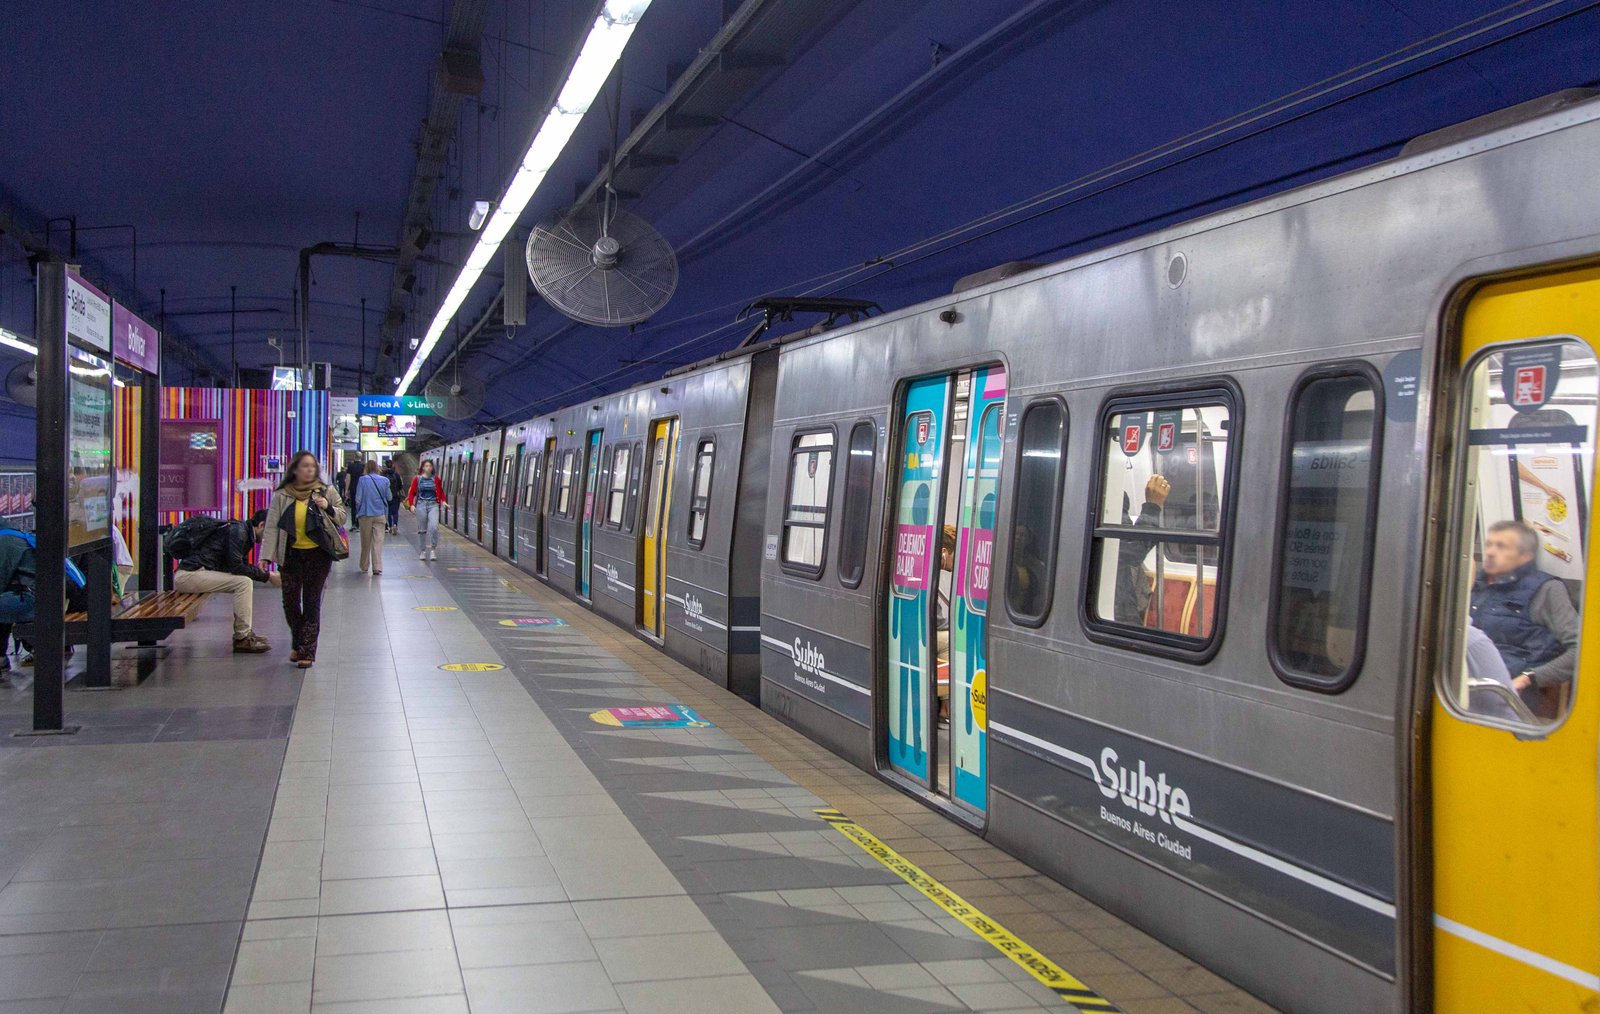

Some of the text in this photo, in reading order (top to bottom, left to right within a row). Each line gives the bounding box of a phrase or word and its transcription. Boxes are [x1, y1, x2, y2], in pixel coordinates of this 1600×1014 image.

[71, 289, 86, 317] Salida
[369, 400, 401, 409] Línea A
[414, 400, 435, 409] Línea
[898, 532, 926, 556] DEJEMOS
[896, 555, 915, 577] BAJAR
[973, 565, 989, 590] SUB
[684, 592, 703, 619] Subte
[793, 636, 825, 675] Subte
[1099, 746, 1192, 825] Subte
[1100, 805, 1192, 860] Buenos Aires Ciudad
[870, 846, 891, 858] CON
[895, 865, 935, 888] ESPACIO
[966, 916, 1001, 935] TREN
[1000, 941, 1021, 951] EL
